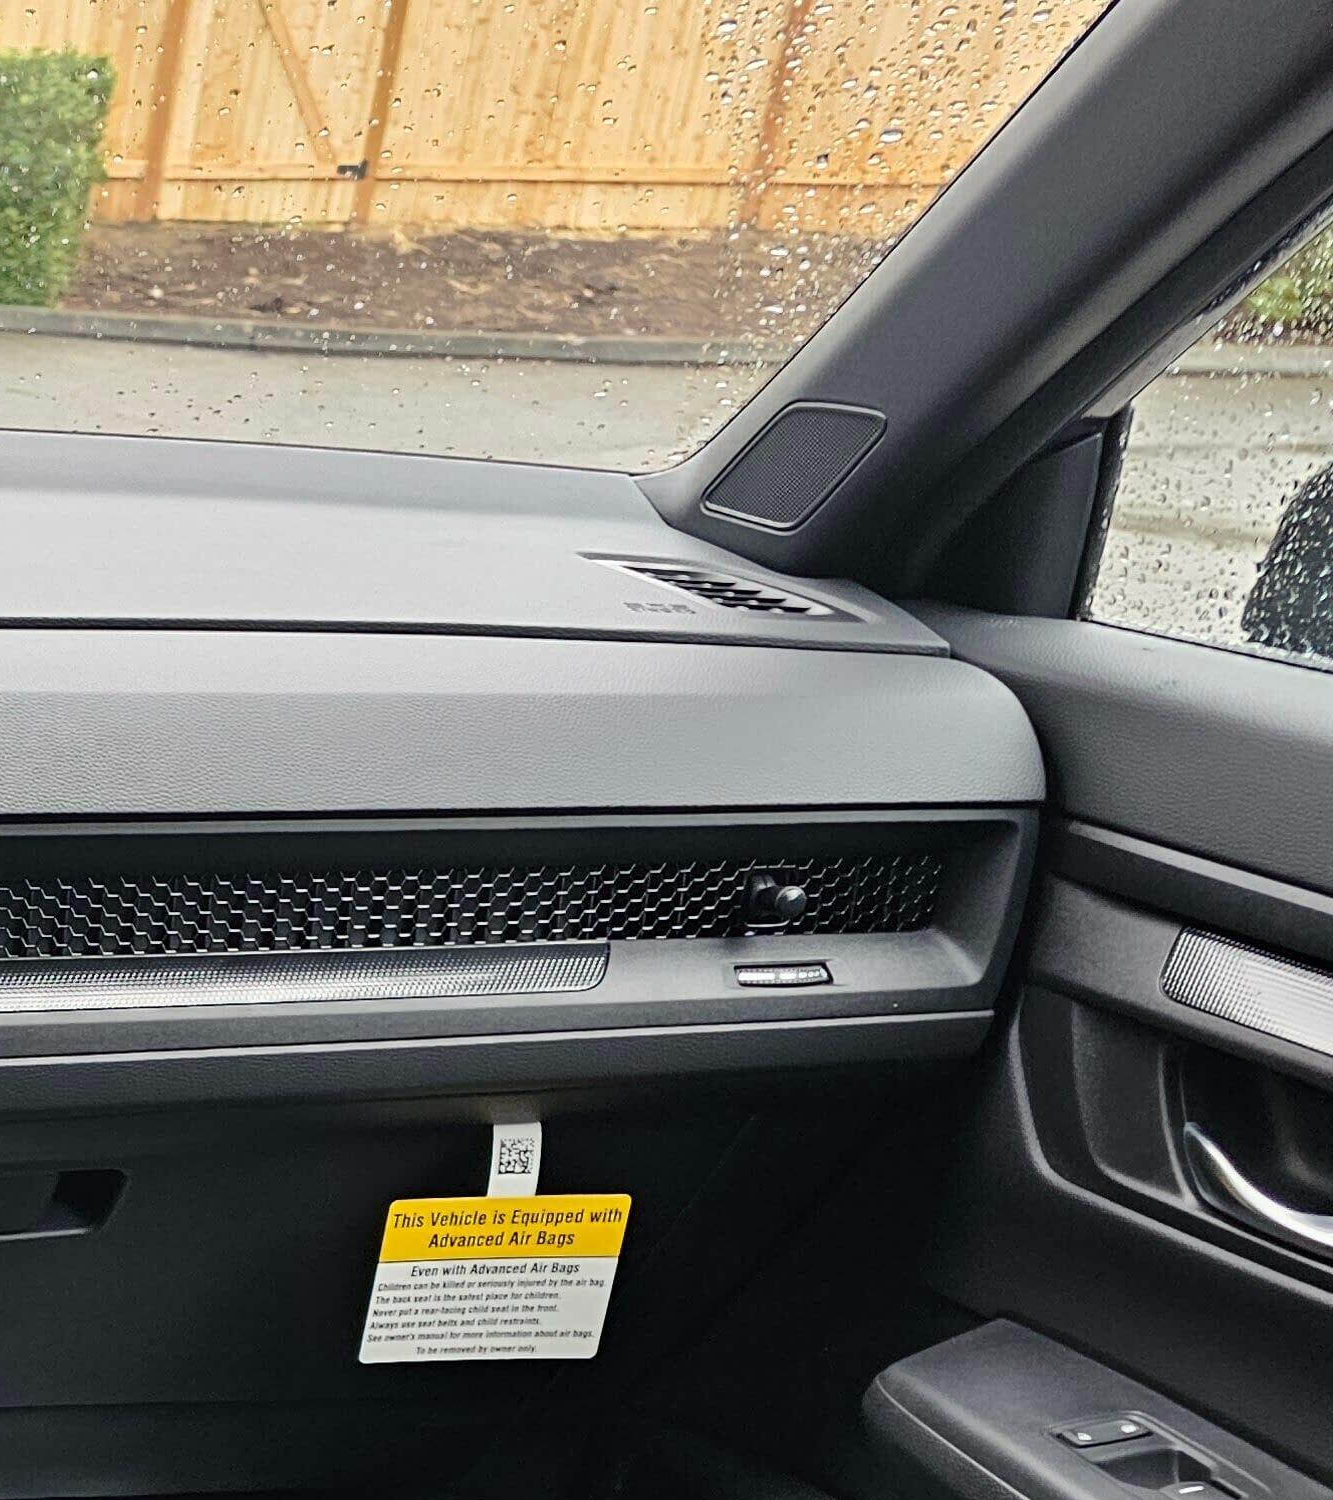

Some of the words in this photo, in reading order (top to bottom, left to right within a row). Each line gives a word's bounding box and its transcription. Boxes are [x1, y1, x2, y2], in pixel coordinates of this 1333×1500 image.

[393, 1212, 425, 1229] This
[430, 1210, 487, 1227] Vehicle
[493, 1210, 506, 1225] is
[511, 1208, 585, 1227] Equipped
[590, 1207, 623, 1224] with
[428, 1231, 505, 1249] Advanced
[508, 1230, 532, 1247] Air
[536, 1230, 575, 1249] Bags
[410, 1265, 439, 1277] Even
[442, 1264, 467, 1276] with
[469, 1262, 528, 1275] Advanced
[530, 1262, 549, 1274] Air
[551, 1261, 581, 1275] Bags
[377, 1282, 412, 1292] Children
[431, 1281, 441, 1290] be
[443, 1280, 466, 1289] killed
[467, 1281, 477, 1289] or
[478, 1279, 515, 1288] seriously
[517, 1278, 547, 1287] injured
[548, 1278, 558, 1288] by
[560, 1278, 573, 1287] the
[575, 1278, 587, 1286] air
[376, 1296, 391, 1304] The
[393, 1295, 412, 1304] back
[414, 1294, 433, 1303] seat
[443, 1293, 456, 1302] the
[373, 1309, 397, 1318] Never
[398, 1307, 413, 1318] put
[468, 1305, 489, 1314] child
[369, 1322, 399, 1331] Always
